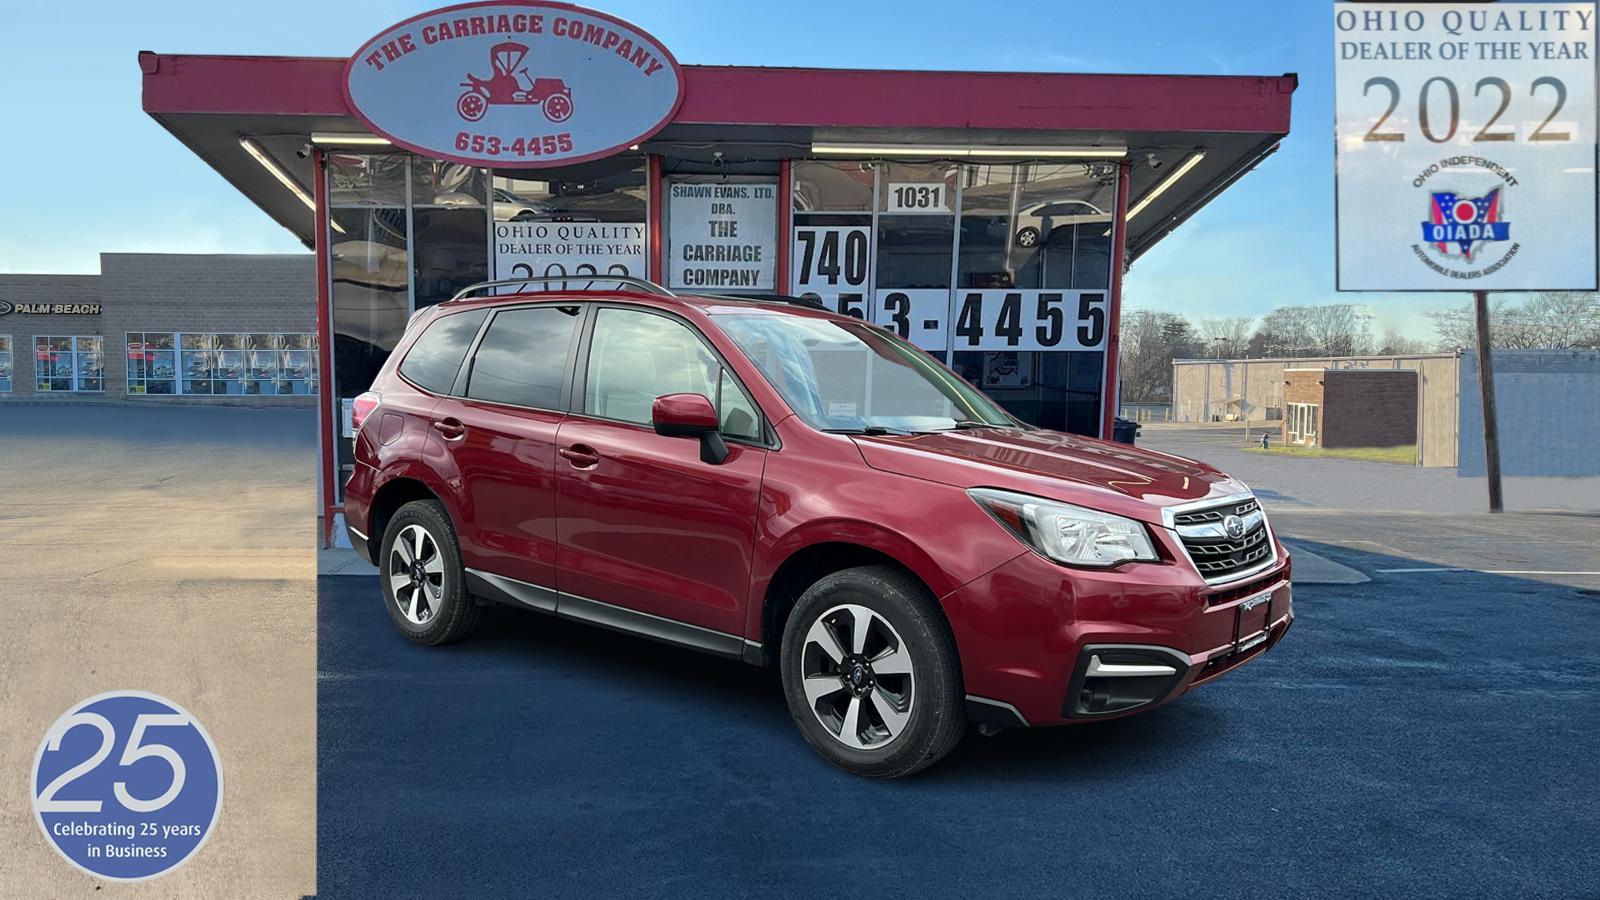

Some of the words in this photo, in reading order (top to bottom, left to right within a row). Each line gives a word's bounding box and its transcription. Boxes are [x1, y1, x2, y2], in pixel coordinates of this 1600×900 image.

[1336, 10, 1425, 31] OHIO
[1442, 10, 1592, 36] QUALITY
[365, 33, 417, 72] THE
[422, 14, 544, 45] CARRIAGE
[552, 16, 664, 77] COMPANY
[1340, 42, 1433, 60] DEALER
[1438, 42, 1469, 60] OF
[1475, 42, 1522, 60] THE
[1528, 42, 1589, 60] YEAR
[1362, 76, 1571, 143] 2022
[454, 131, 573, 156] 653-4455
[1412, 163, 1440, 188] OHIO
[1440, 155, 1519, 188] INDEPENDENT
[672, 186, 712, 199] SHAWN
[754, 187, 775, 199] LTD.
[894, 186, 940, 208] 1031
[711, 203, 735, 215] DBA.
[497, 226, 548, 238] OHIO
[557, 226, 644, 240] QUALITY
[708, 220, 738, 237] THE
[1432, 224, 1495, 240] OIADA
[499, 244, 552, 255] DEALER
[555, 244, 573, 255] OF
[576, 244, 603, 255] THE
[606, 244, 641, 255] YEAR
[683, 244, 762, 262] CARRIAGE
[797, 230, 868, 286] 740
[683, 268, 760, 286] COMPANY
[1450, 270, 1482, 280] DEALERS
[14, 303, 51, 314] PALM
[54, 303, 100, 314] BEACH
